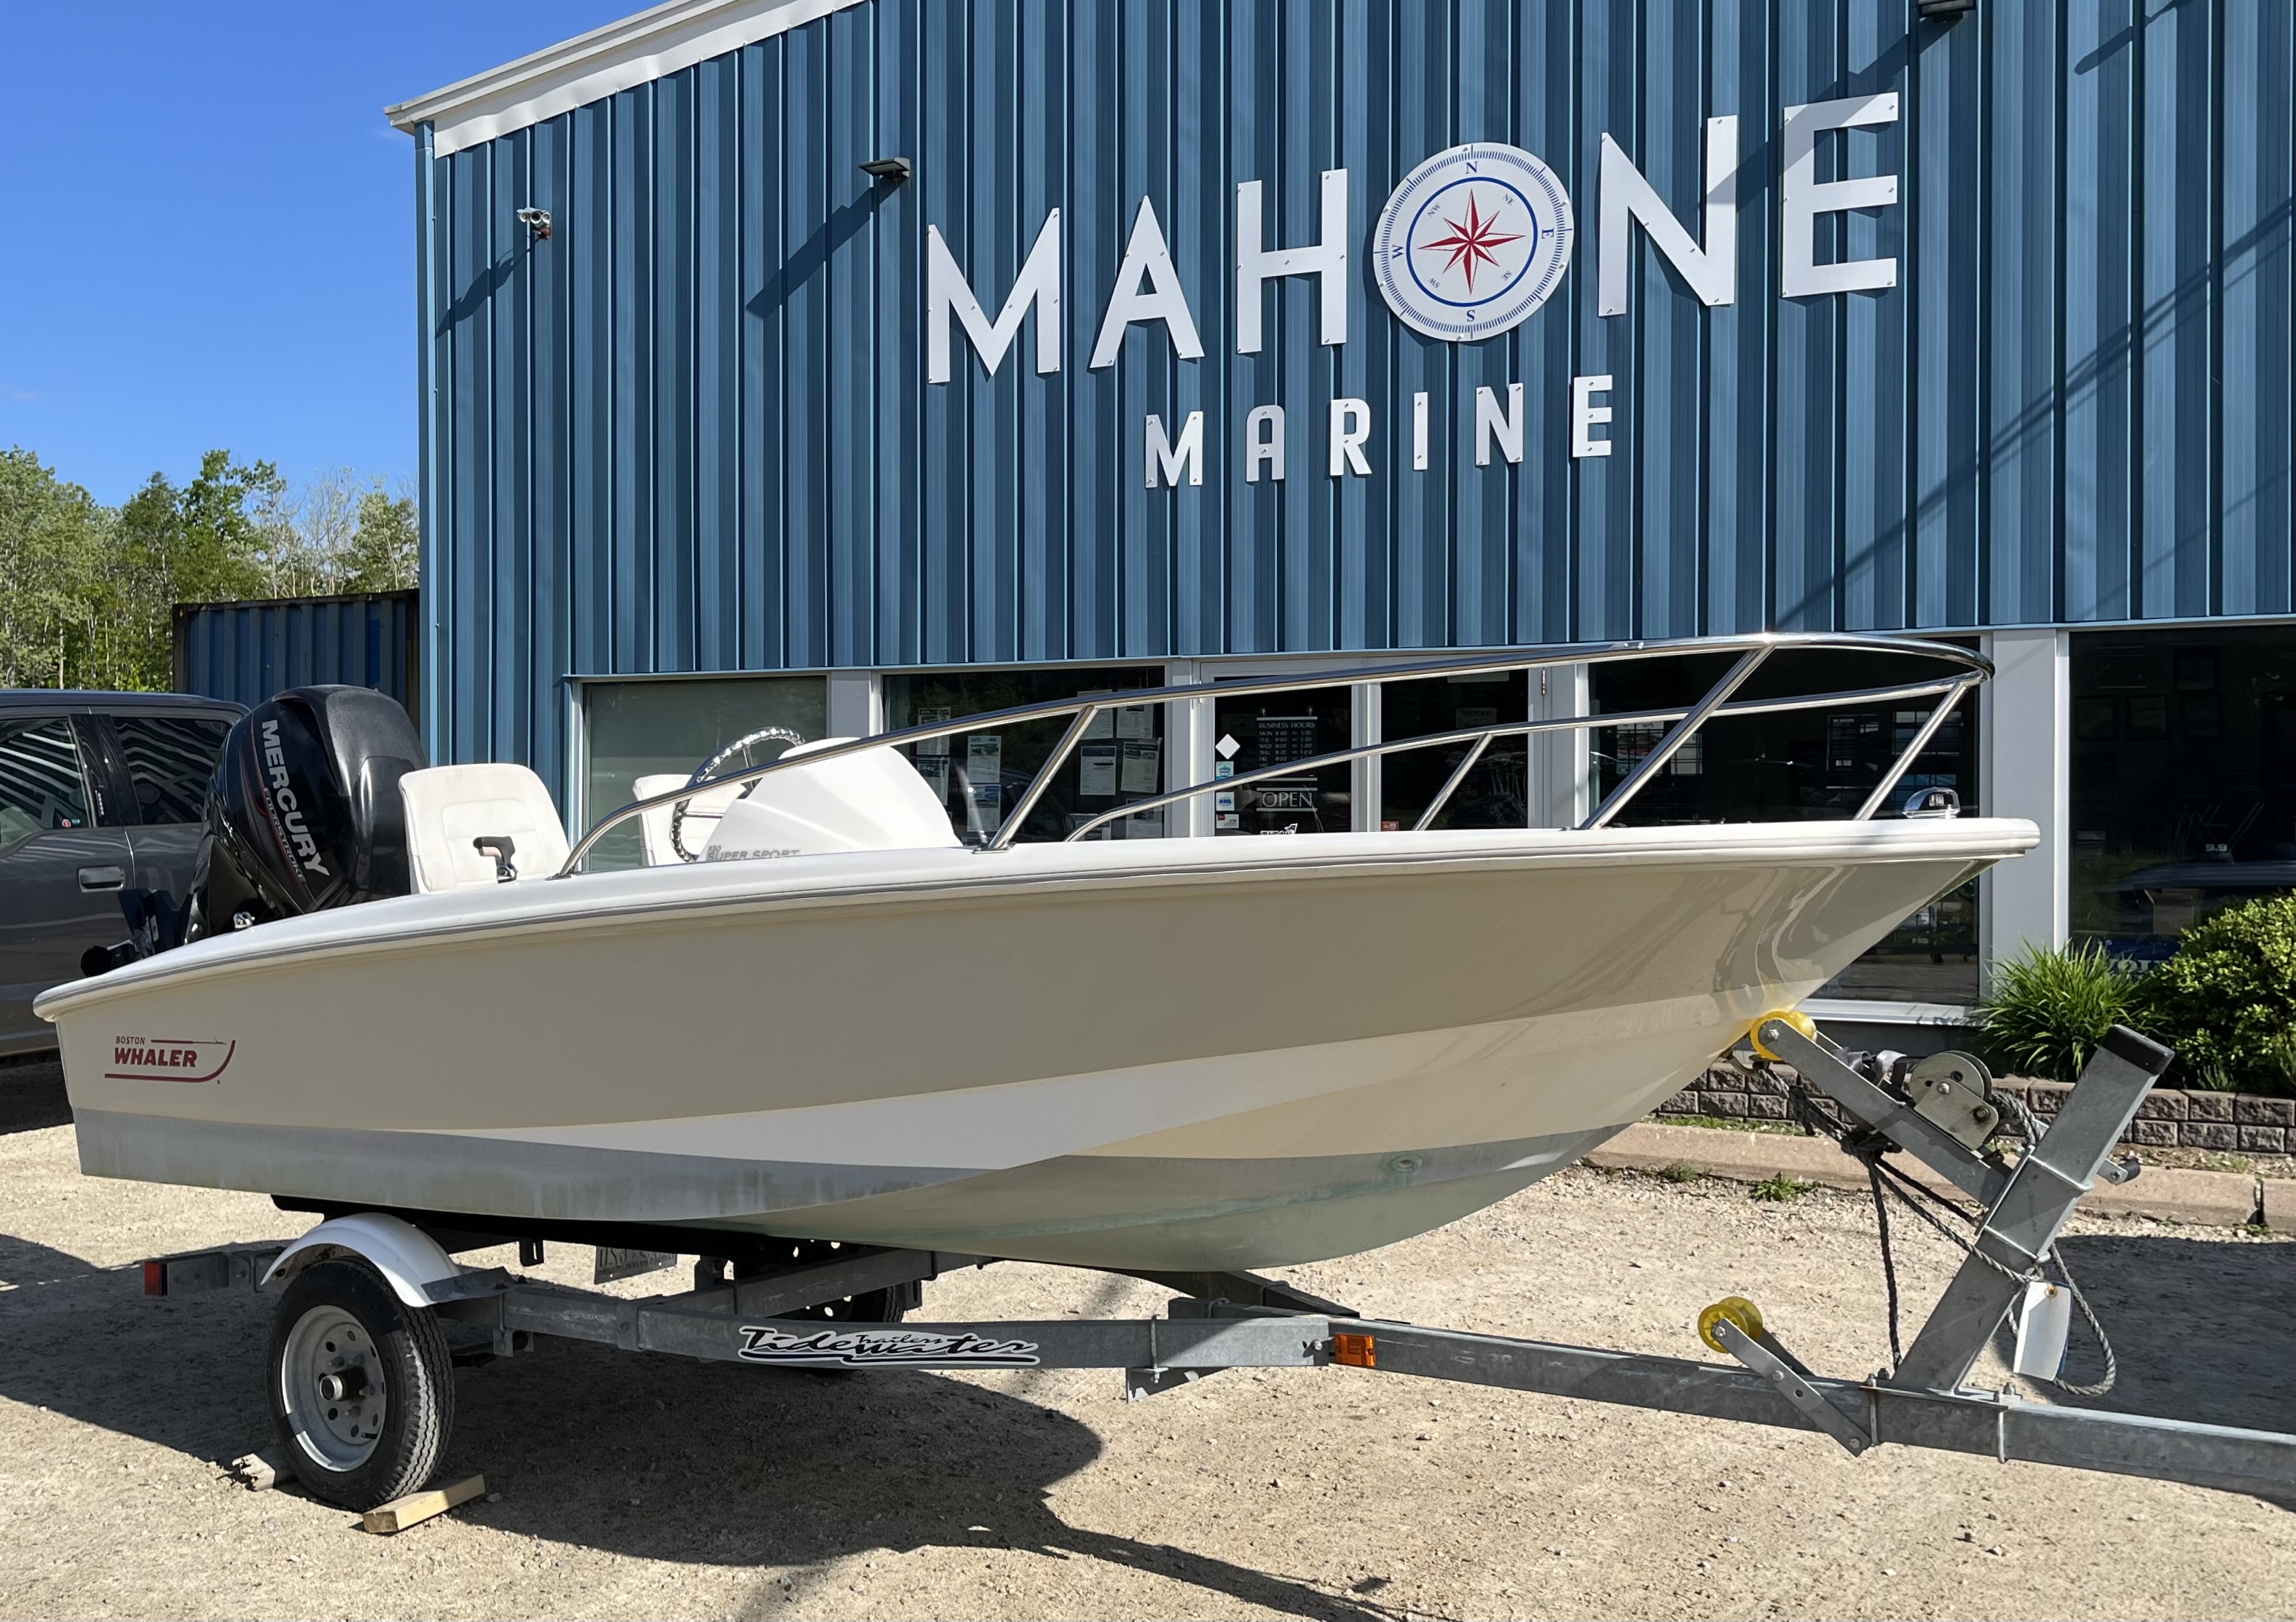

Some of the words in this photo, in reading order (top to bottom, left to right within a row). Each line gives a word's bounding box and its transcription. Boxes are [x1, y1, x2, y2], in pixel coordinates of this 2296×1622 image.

[1146, 374, 1613, 489] MARINE
[262, 720, 330, 876] MERCURY
[1262, 792, 1313, 808] OPEN
[707, 851, 748, 861] SUPER
[115, 1036, 146, 1045] BOSTON
[114, 1047, 197, 1068] WHALER
